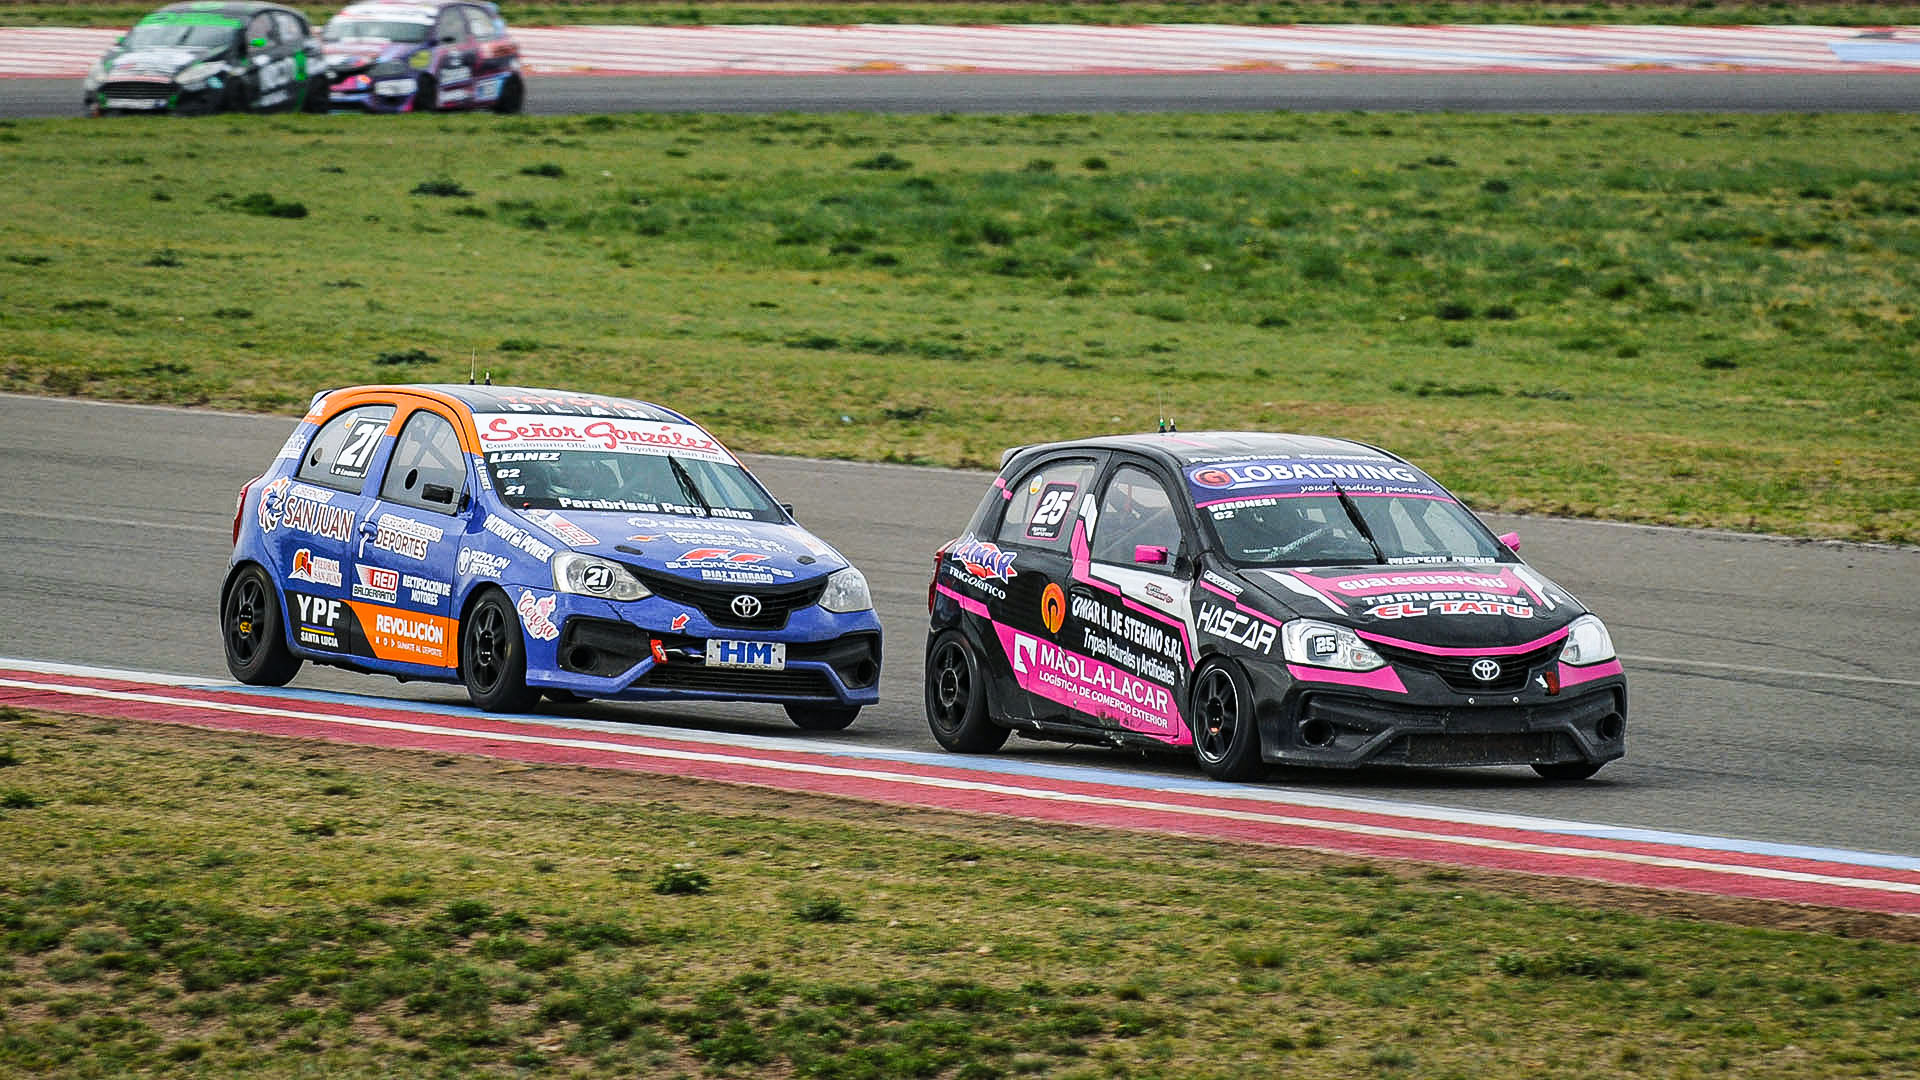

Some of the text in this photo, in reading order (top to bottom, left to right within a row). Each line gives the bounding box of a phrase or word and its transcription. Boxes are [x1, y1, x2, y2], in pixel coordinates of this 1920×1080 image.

[480, 417, 714, 449] Señor González
[336, 423, 386, 468] 21
[490, 452, 561, 463] LEANEZ
[496, 468, 521, 478] C2
[1194, 464, 1418, 486] GLOBALWING
[504, 485, 526, 495] 21
[1300, 483, 1330, 494] your
[1385, 486, 1434, 495] partner
[558, 497, 753, 520] Parabrisas Pergmino
[1031, 490, 1075, 525] 25
[1208, 498, 1277, 512] VERONESI
[1213, 511, 1235, 520] C2
[284, 497, 355, 542] SAN JUAN
[375, 527, 429, 560] DEPORTES
[519, 534, 555, 563] POWER
[373, 570, 397, 590] RED
[586, 568, 609, 586] 21
[297, 593, 342, 627] YPF
[1361, 592, 1529, 606] TRANSPORTE
[1366, 601, 1427, 619] EL
[518, 592, 556, 639] Cereza
[1071, 595, 1101, 625] OMAR
[1111, 609, 1123, 636] DE
[1123, 615, 1164, 653] STEFANO
[300, 631, 320, 645] SANTA
[376, 613, 444, 645] REVOLUCIÓN
[1196, 601, 1277, 655] HASCAR
[720, 640, 772, 665] HM
[1315, 636, 1336, 652] 25
[1083, 626, 1175, 687] Tripas Naturales y Artificiales
[1079, 686, 1091, 699] DE
[1091, 690, 1131, 714] COMERCIO
[1131, 706, 1168, 729] EXTERIOR
